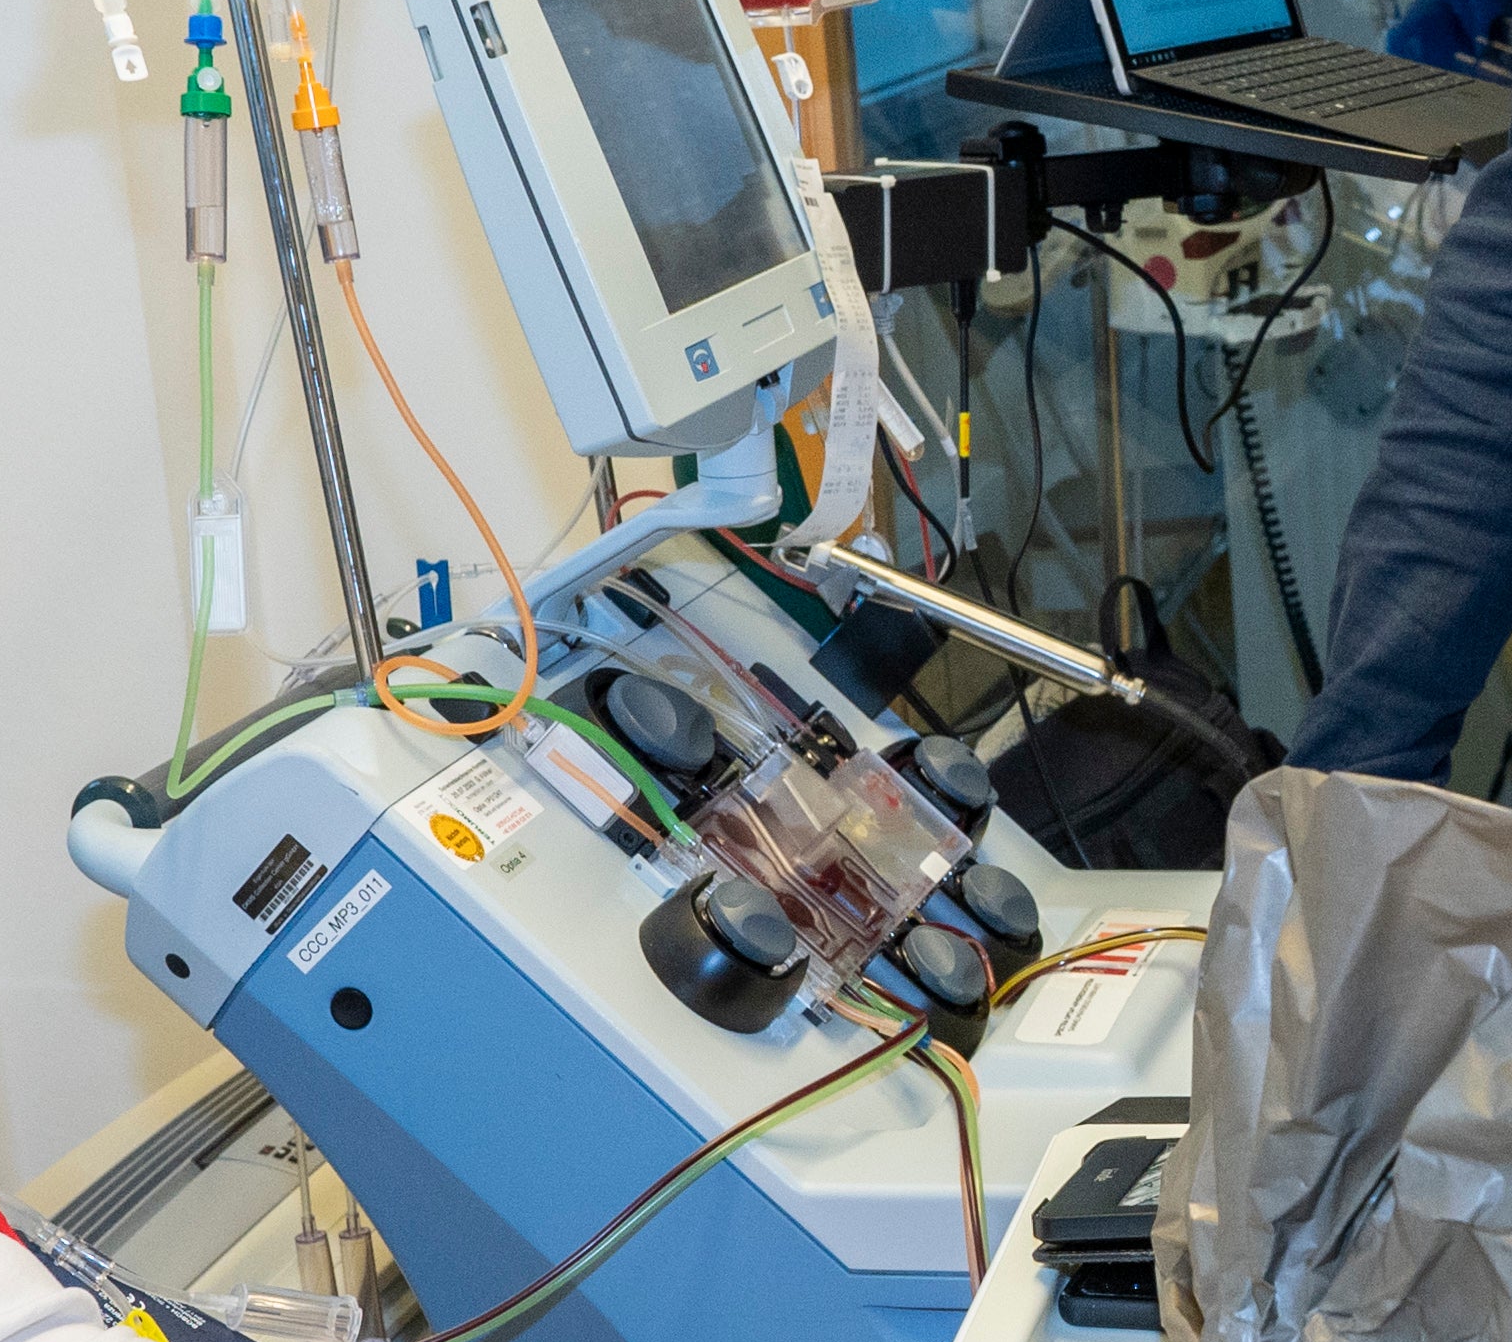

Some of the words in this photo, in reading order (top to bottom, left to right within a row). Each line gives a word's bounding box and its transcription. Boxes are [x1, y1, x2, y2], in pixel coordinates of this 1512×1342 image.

[500, 857, 522, 874] Optia
[518, 850, 527, 861] 4
[298, 876, 383, 962] CCC_MP3_011
